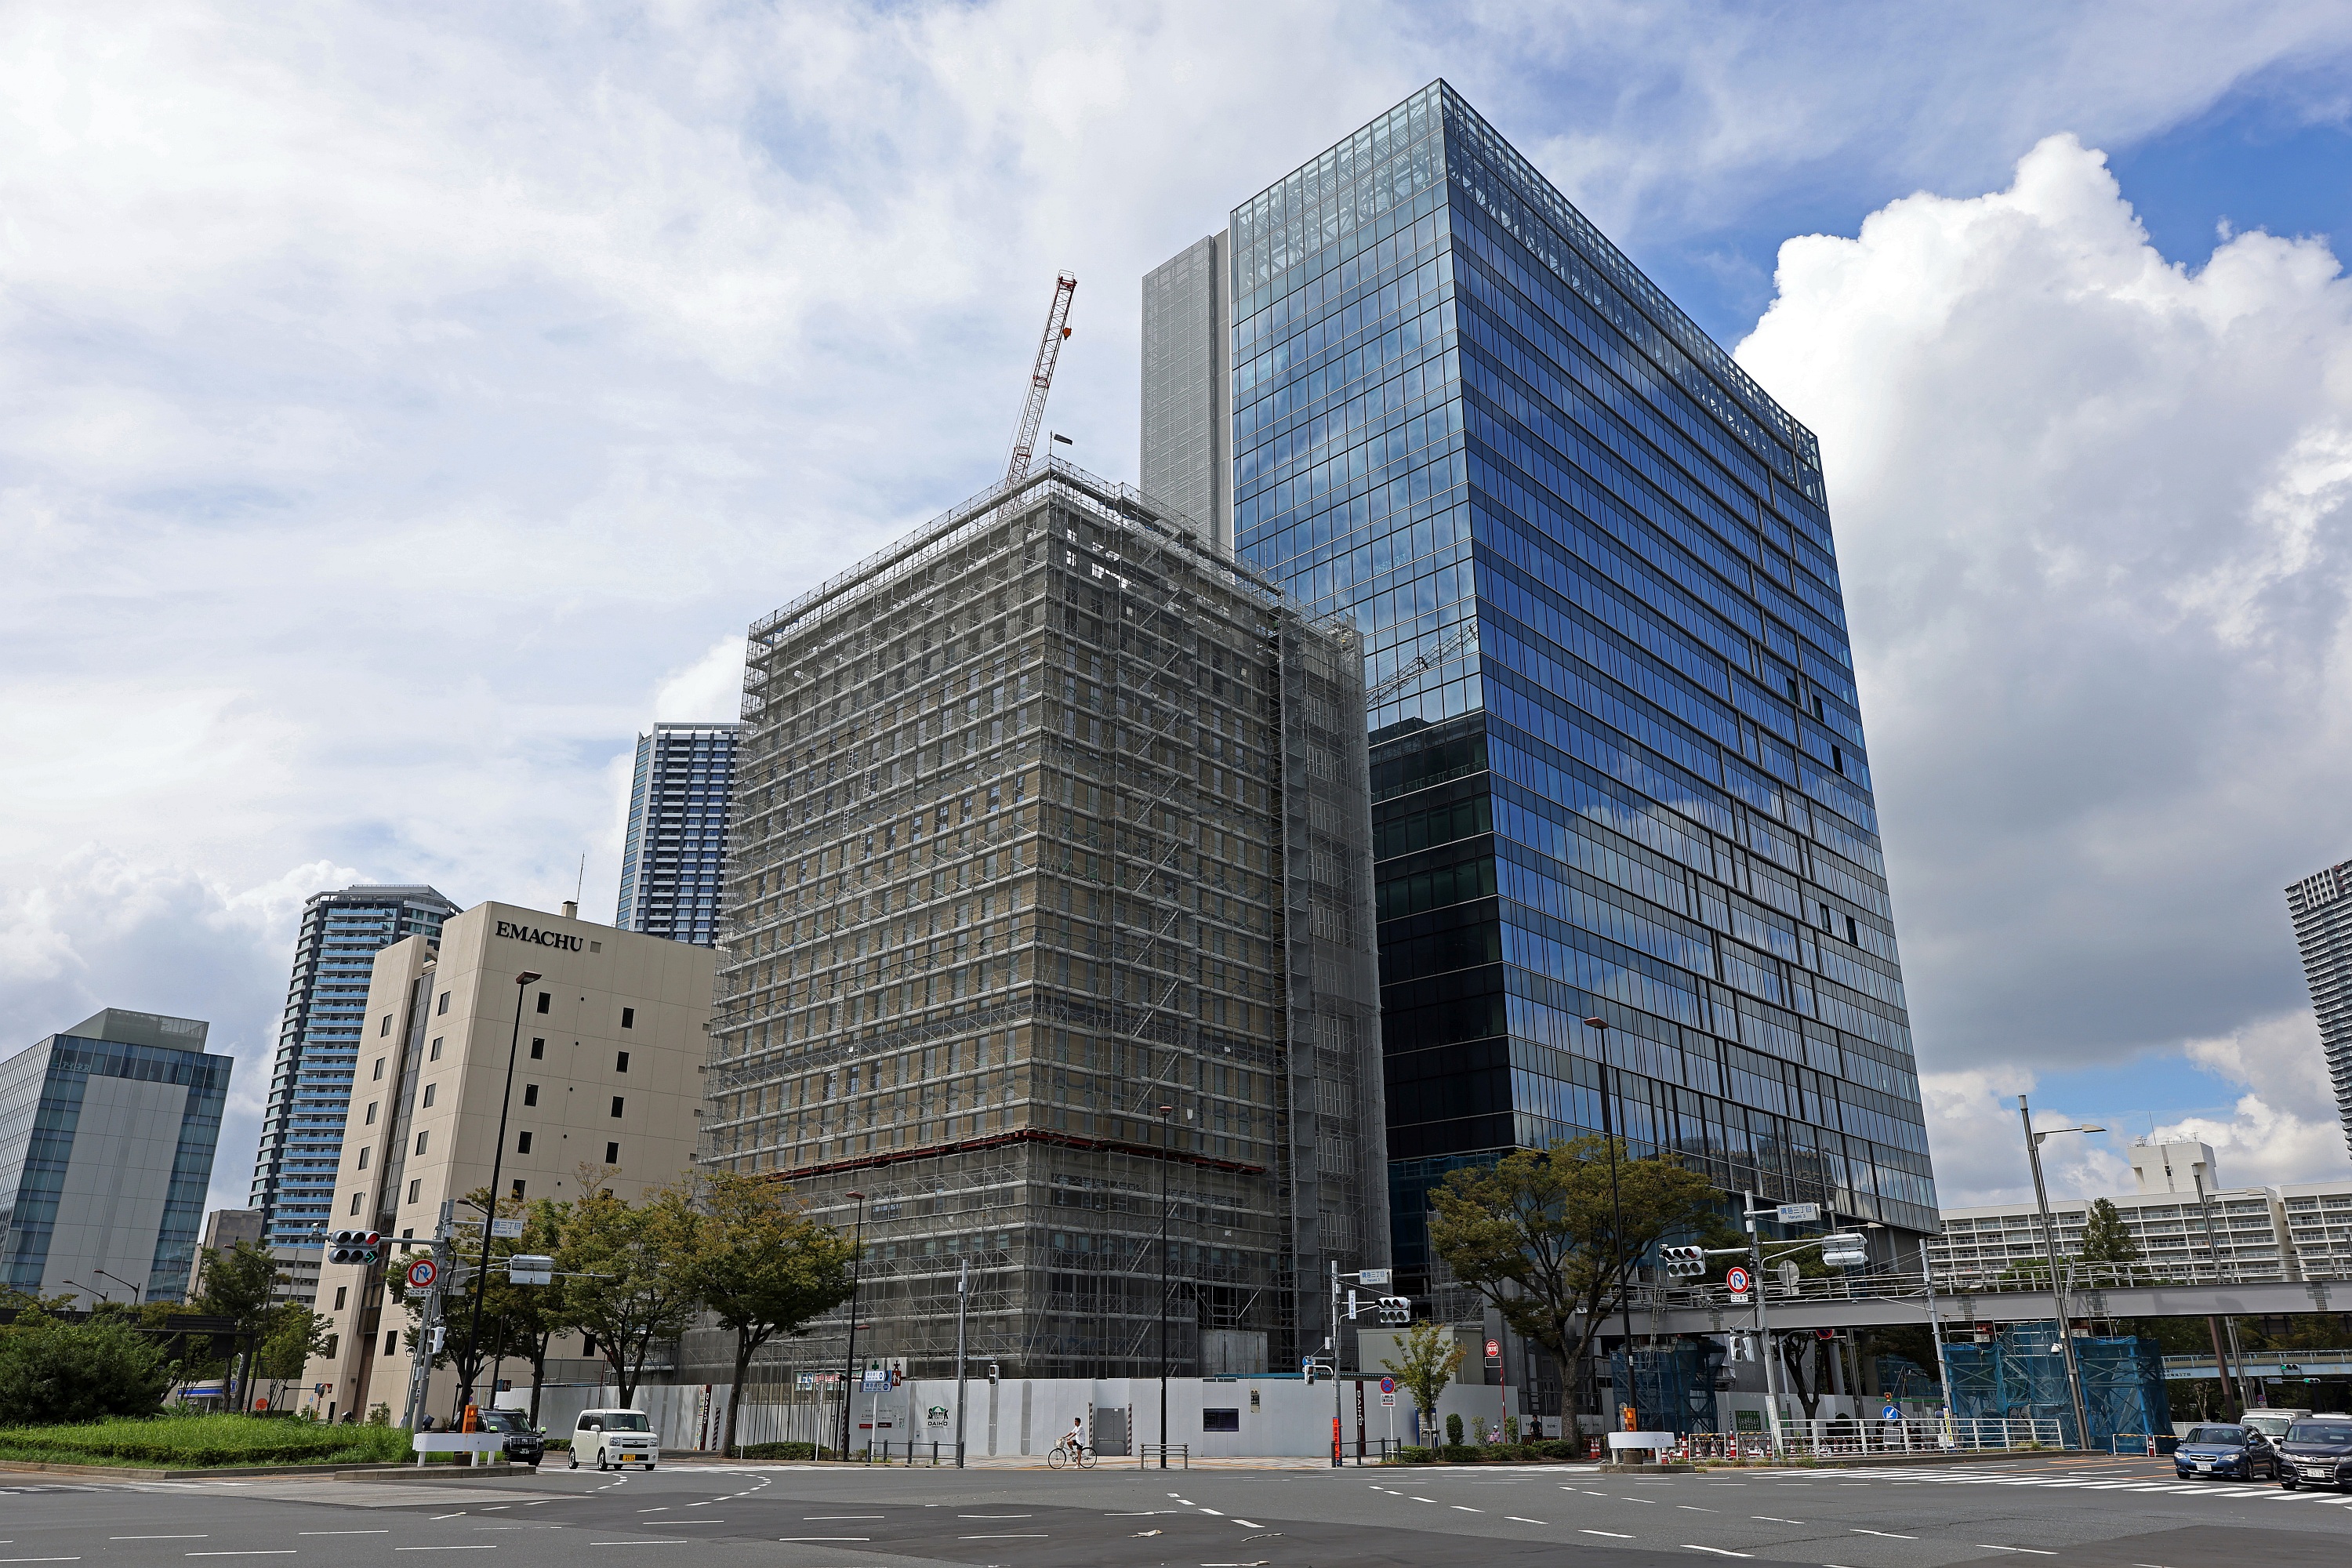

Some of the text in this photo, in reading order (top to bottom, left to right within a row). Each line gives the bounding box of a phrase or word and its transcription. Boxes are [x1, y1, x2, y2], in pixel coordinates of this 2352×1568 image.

[495, 920, 583, 952] EMACHU
[1780, 1205, 1812, 1215] 晴海三丁目
[492, 1220, 521, 1231] 海三丁目
